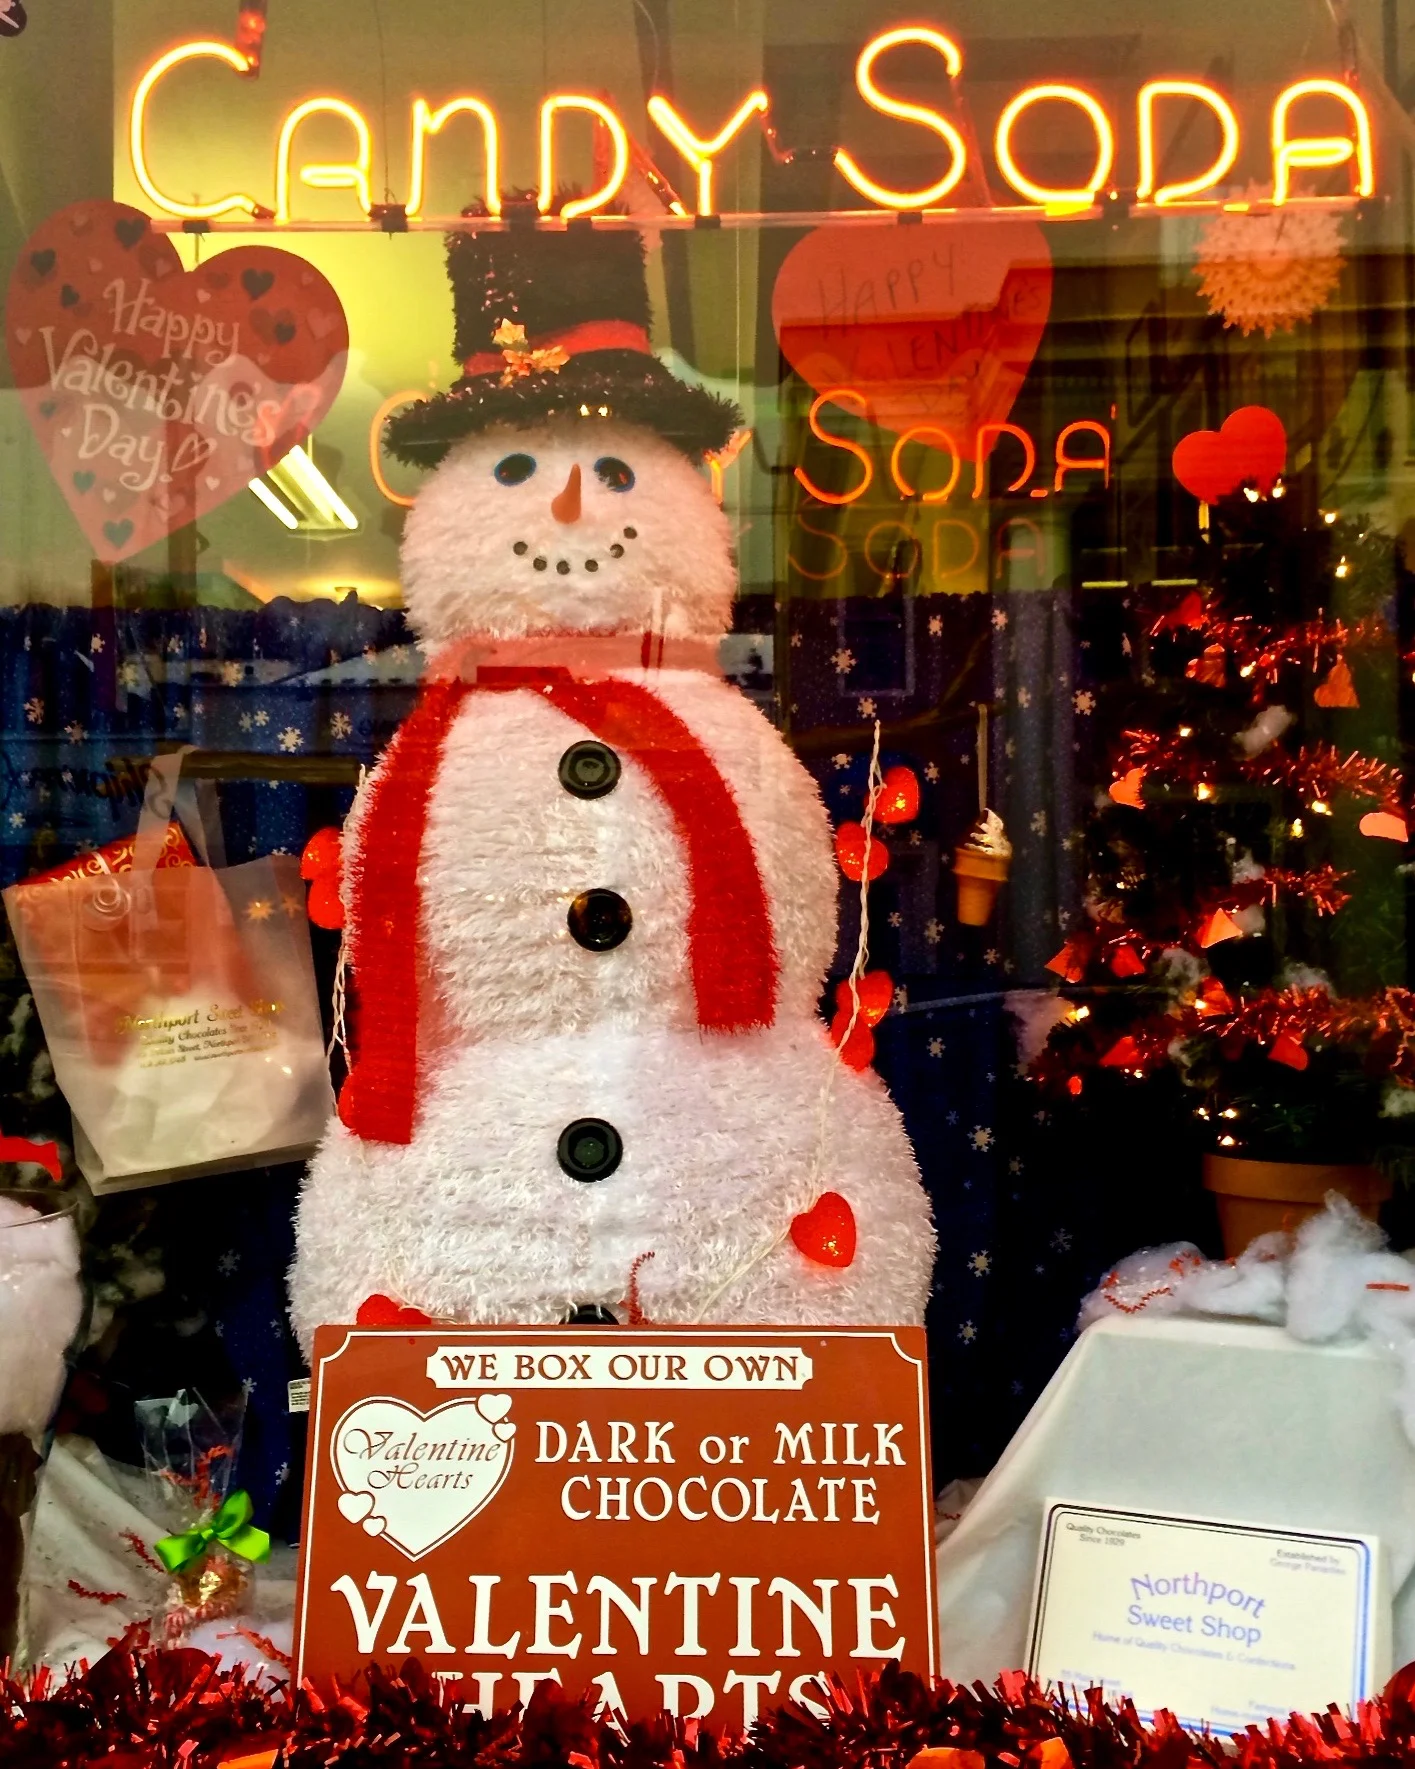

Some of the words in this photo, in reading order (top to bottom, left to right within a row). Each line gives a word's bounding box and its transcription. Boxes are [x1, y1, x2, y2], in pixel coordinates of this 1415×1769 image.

[834, 26, 1374, 208] SODA
[103, 278, 240, 367] Happy
[178, 1026, 227, 1041] Chocolates
[440, 1353, 499, 1382] WE
[513, 1353, 593, 1382] BOX
[609, 1353, 689, 1381] OUR
[704, 1353, 799, 1382] OWN
[343, 1428, 501, 1462] Valentine
[535, 1420, 677, 1465] DARK
[699, 1434, 750, 1465] or
[774, 1421, 908, 1467] MILK
[366, 1462, 474, 1490] Hearts
[560, 1474, 881, 1526] CHOCOLATE
[330, 1569, 907, 1660] VALENTINE
[1130, 1571, 1266, 1619] Northport
[1127, 1603, 1193, 1634] Sweet
[1200, 1614, 1262, 1648] Shop
